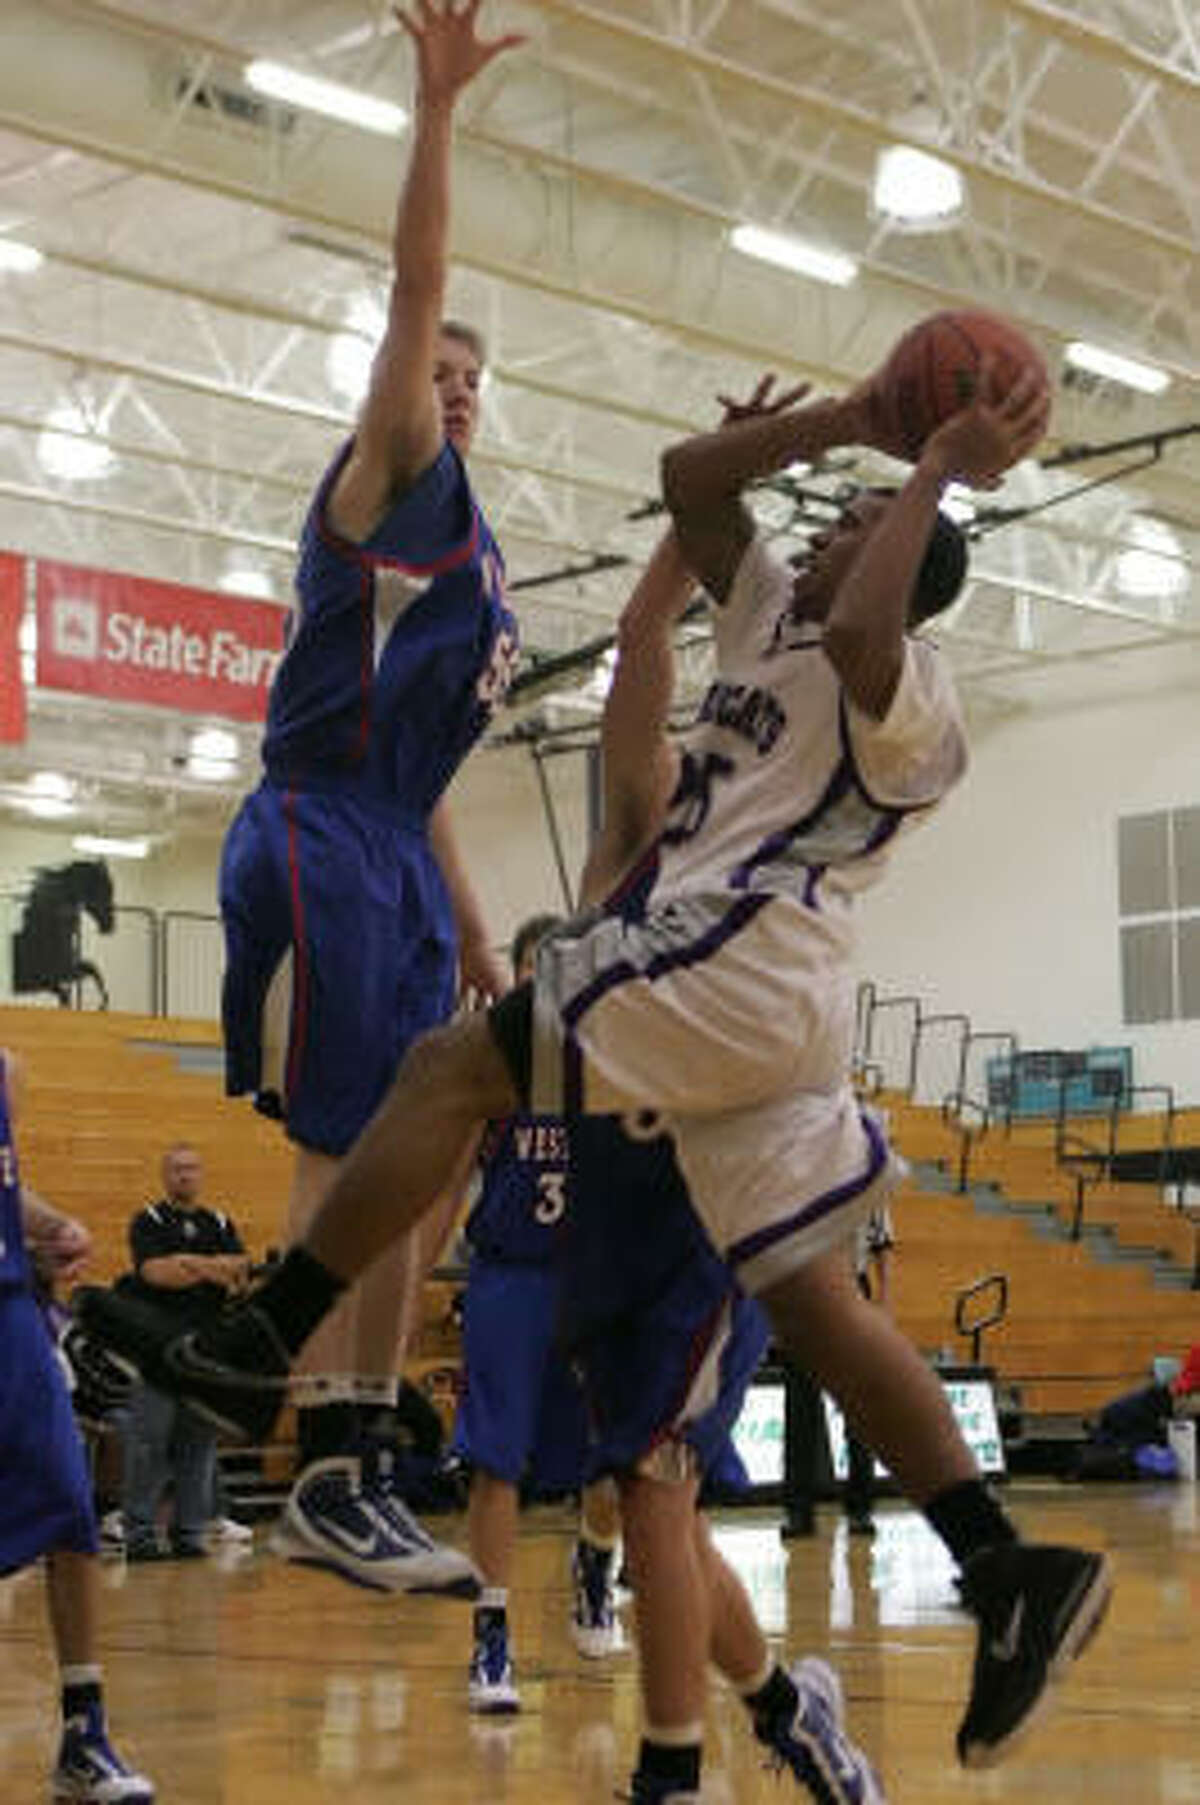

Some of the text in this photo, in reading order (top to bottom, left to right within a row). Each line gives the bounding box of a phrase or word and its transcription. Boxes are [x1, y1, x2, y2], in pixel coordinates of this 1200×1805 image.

[104, 611, 208, 677] State
[513, 1126, 570, 1160] WES
[535, 1172, 565, 1223] 3
